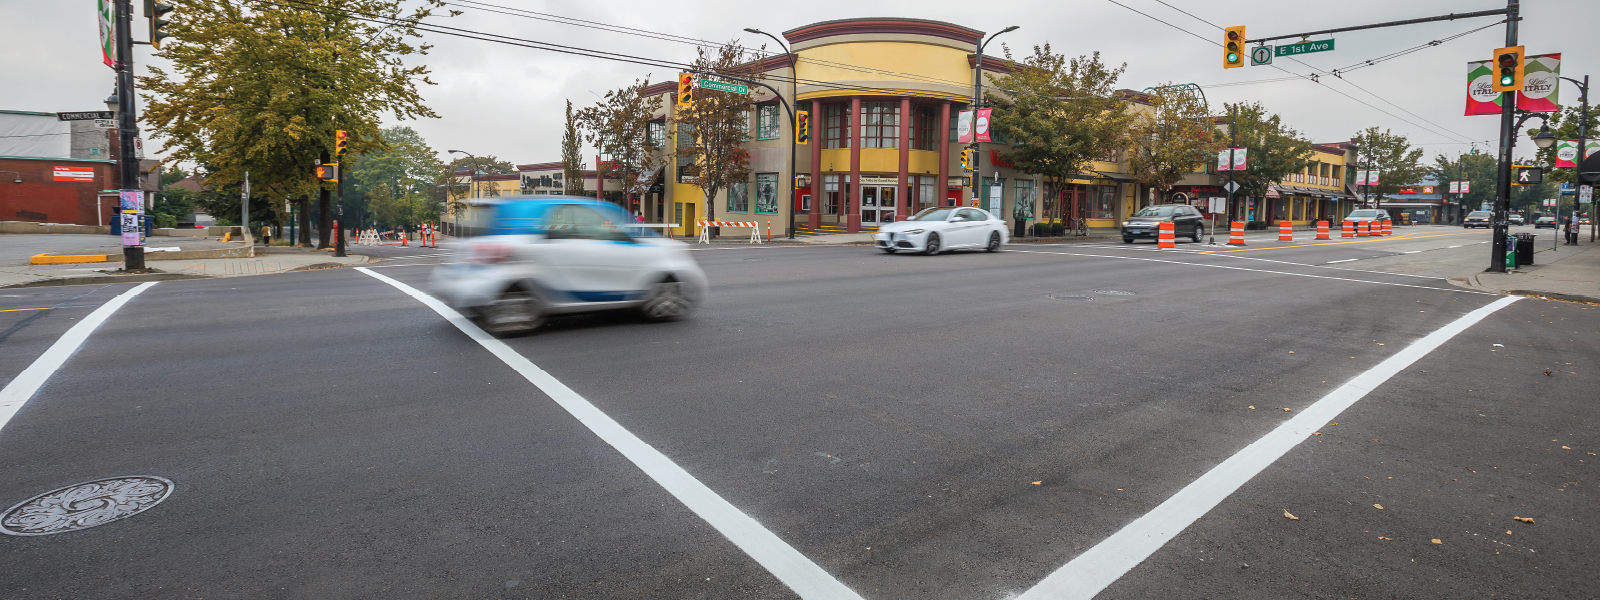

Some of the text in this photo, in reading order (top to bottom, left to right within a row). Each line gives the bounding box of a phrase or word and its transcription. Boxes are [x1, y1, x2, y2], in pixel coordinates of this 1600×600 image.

[1280, 43, 1329, 55] E 1st Ave
[703, 80, 737, 92] Commercial
[1524, 84, 1552, 92] ITALY
[62, 112, 101, 120] COMMERCIAL
